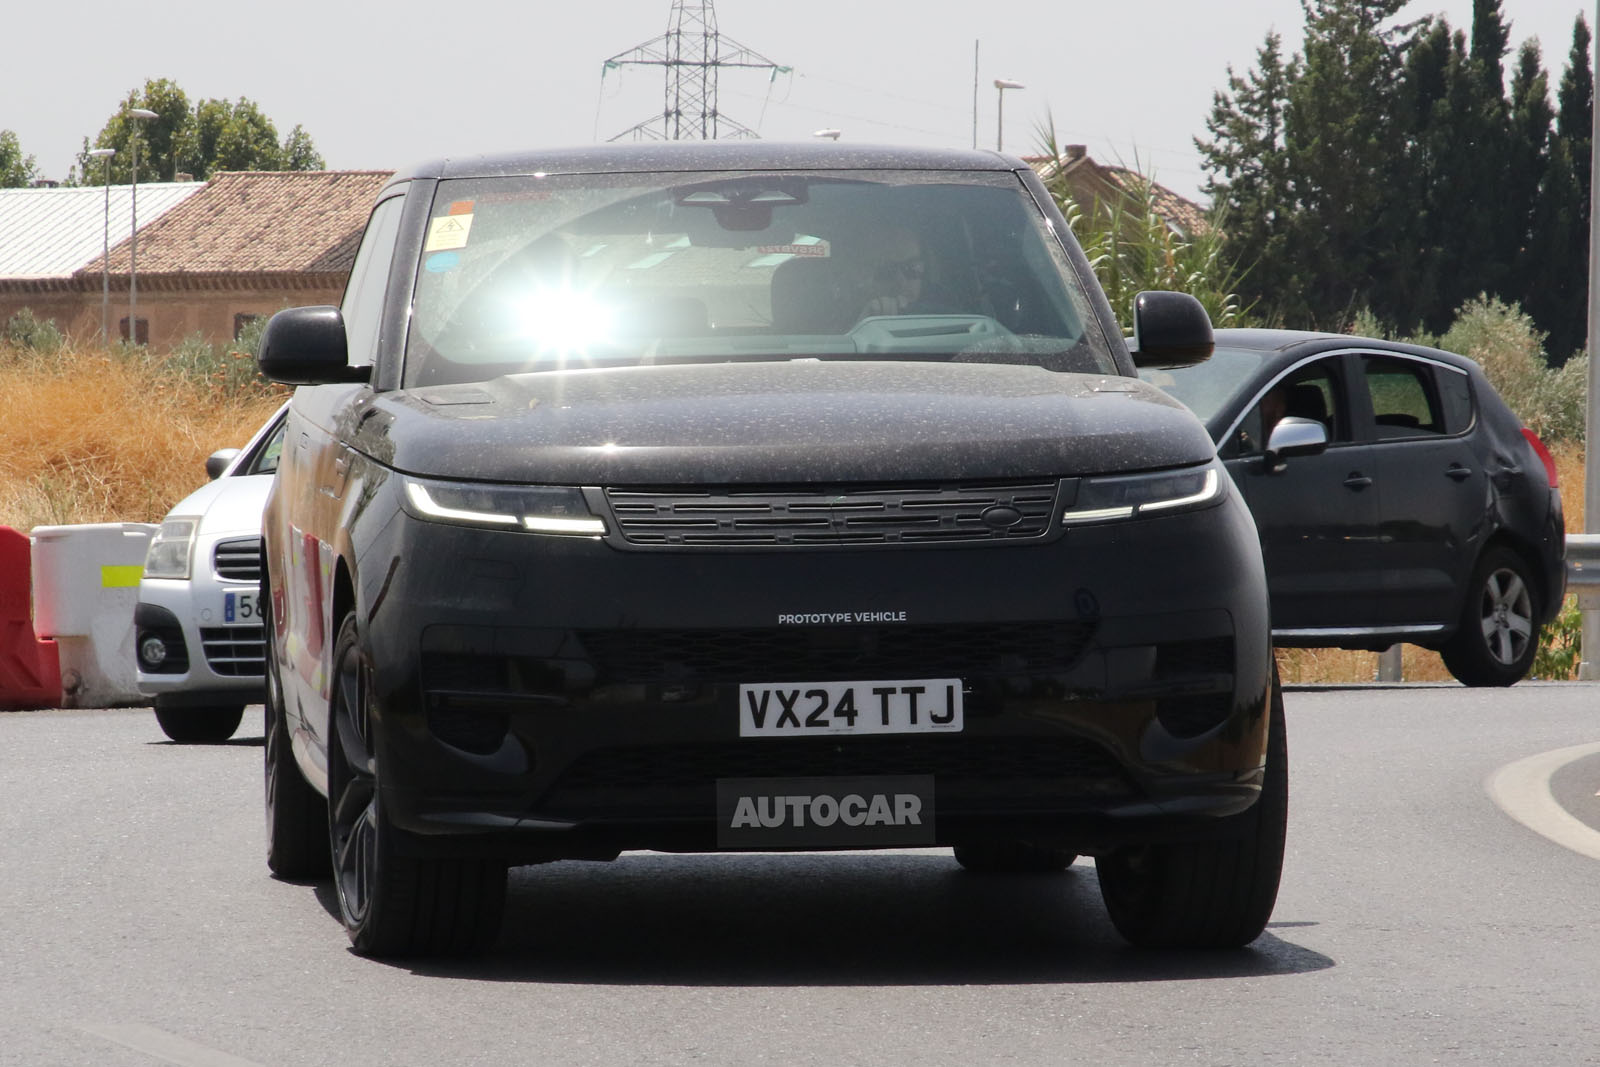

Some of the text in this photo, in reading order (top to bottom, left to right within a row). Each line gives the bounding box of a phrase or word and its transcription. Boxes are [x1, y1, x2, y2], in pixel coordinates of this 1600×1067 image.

[778, 611, 907, 624] PROTOTYPE VEHICLE
[746, 685, 954, 728] VX24 TTJ
